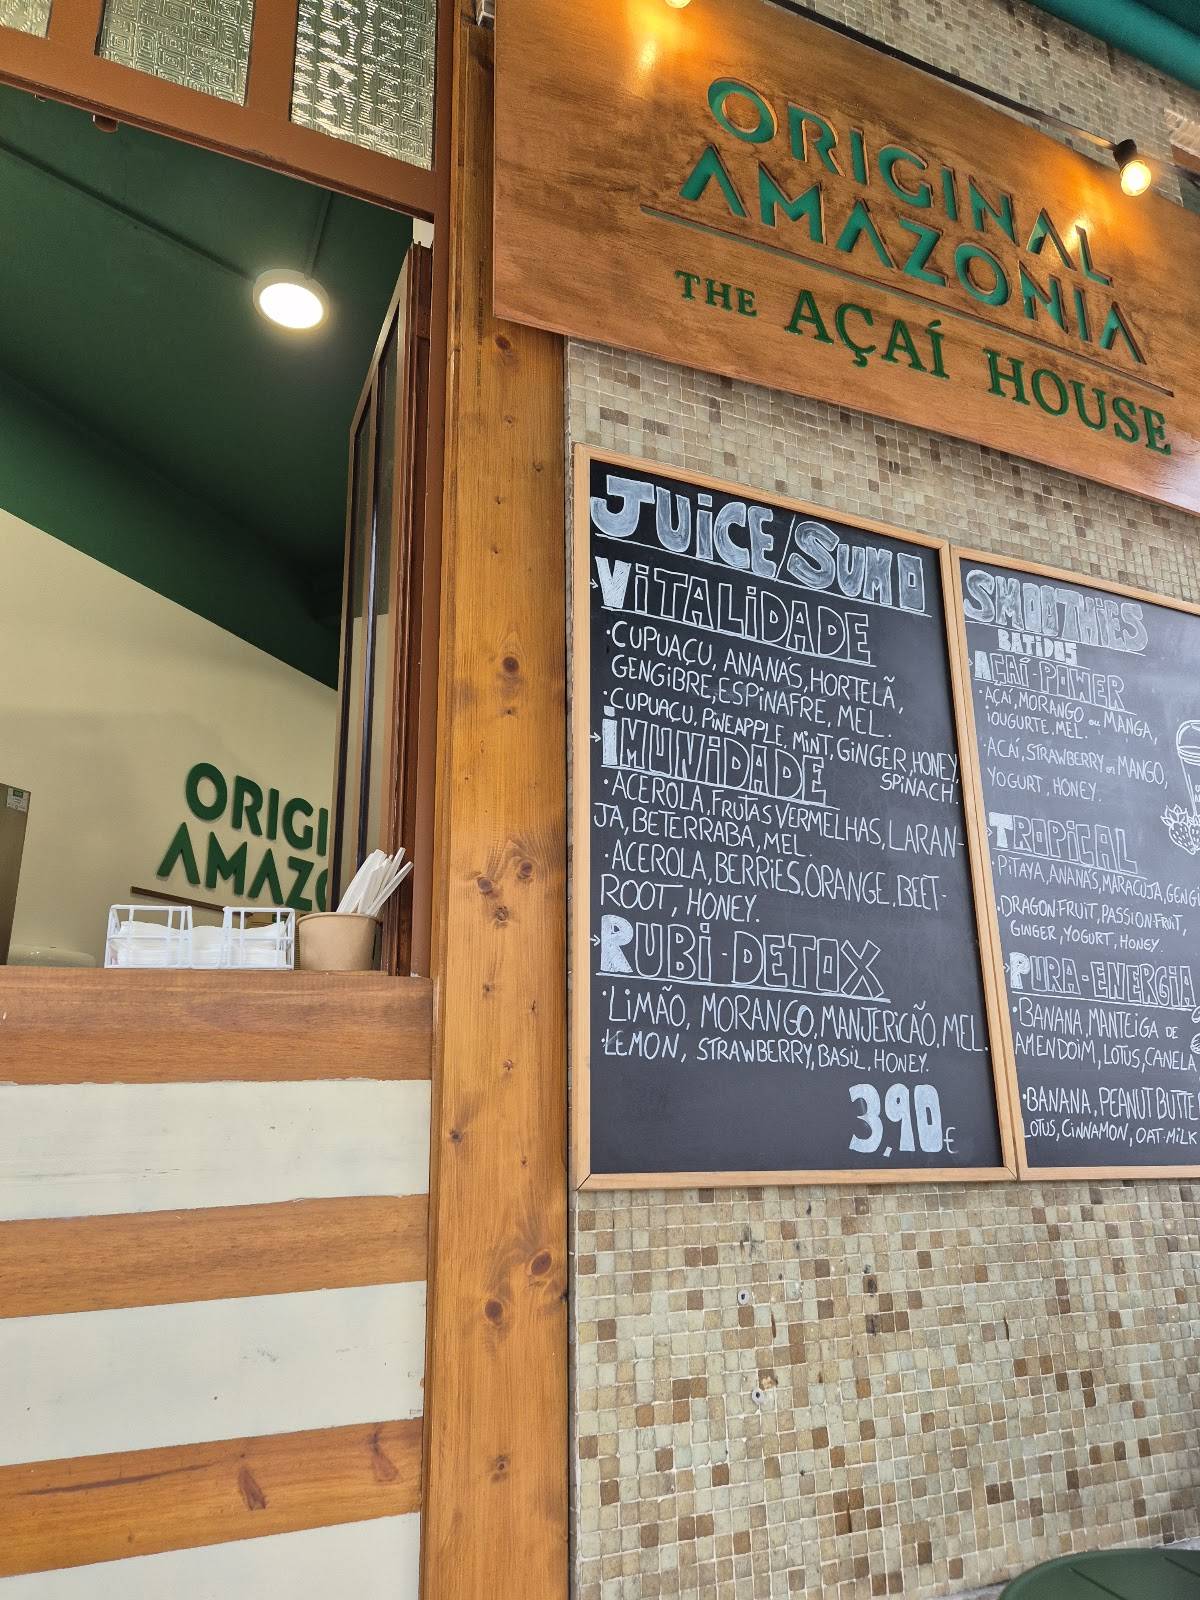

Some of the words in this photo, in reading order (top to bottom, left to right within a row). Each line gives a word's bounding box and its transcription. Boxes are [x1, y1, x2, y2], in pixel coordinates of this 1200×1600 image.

[707, 76, 1113, 287] ORIGINAL
[680, 143, 1147, 365] AMAZONIA
[675, 270, 757, 317] THE
[785, 289, 949, 378] AÇAÍ
[983, 347, 1171, 455] HOUSE
[838, 705, 892, 738] MEL.
[1019, 692, 1084, 722] MORANGO
[1026, 744, 1104, 772] STRAWBERRY
[633, 807, 760, 853] BETERRABA,
[156, 821, 327, 912] AMAZ
[687, 888, 760, 922] HONEY.
[605, 1029, 686, 1062] LEMON,
[875, 1049, 929, 1073] HONEY.
[1166, 1026, 1180, 1039] DE
[1099, 1087, 1153, 1120] PEANUT
[1156, 1087, 1200, 1120] BUTTE
